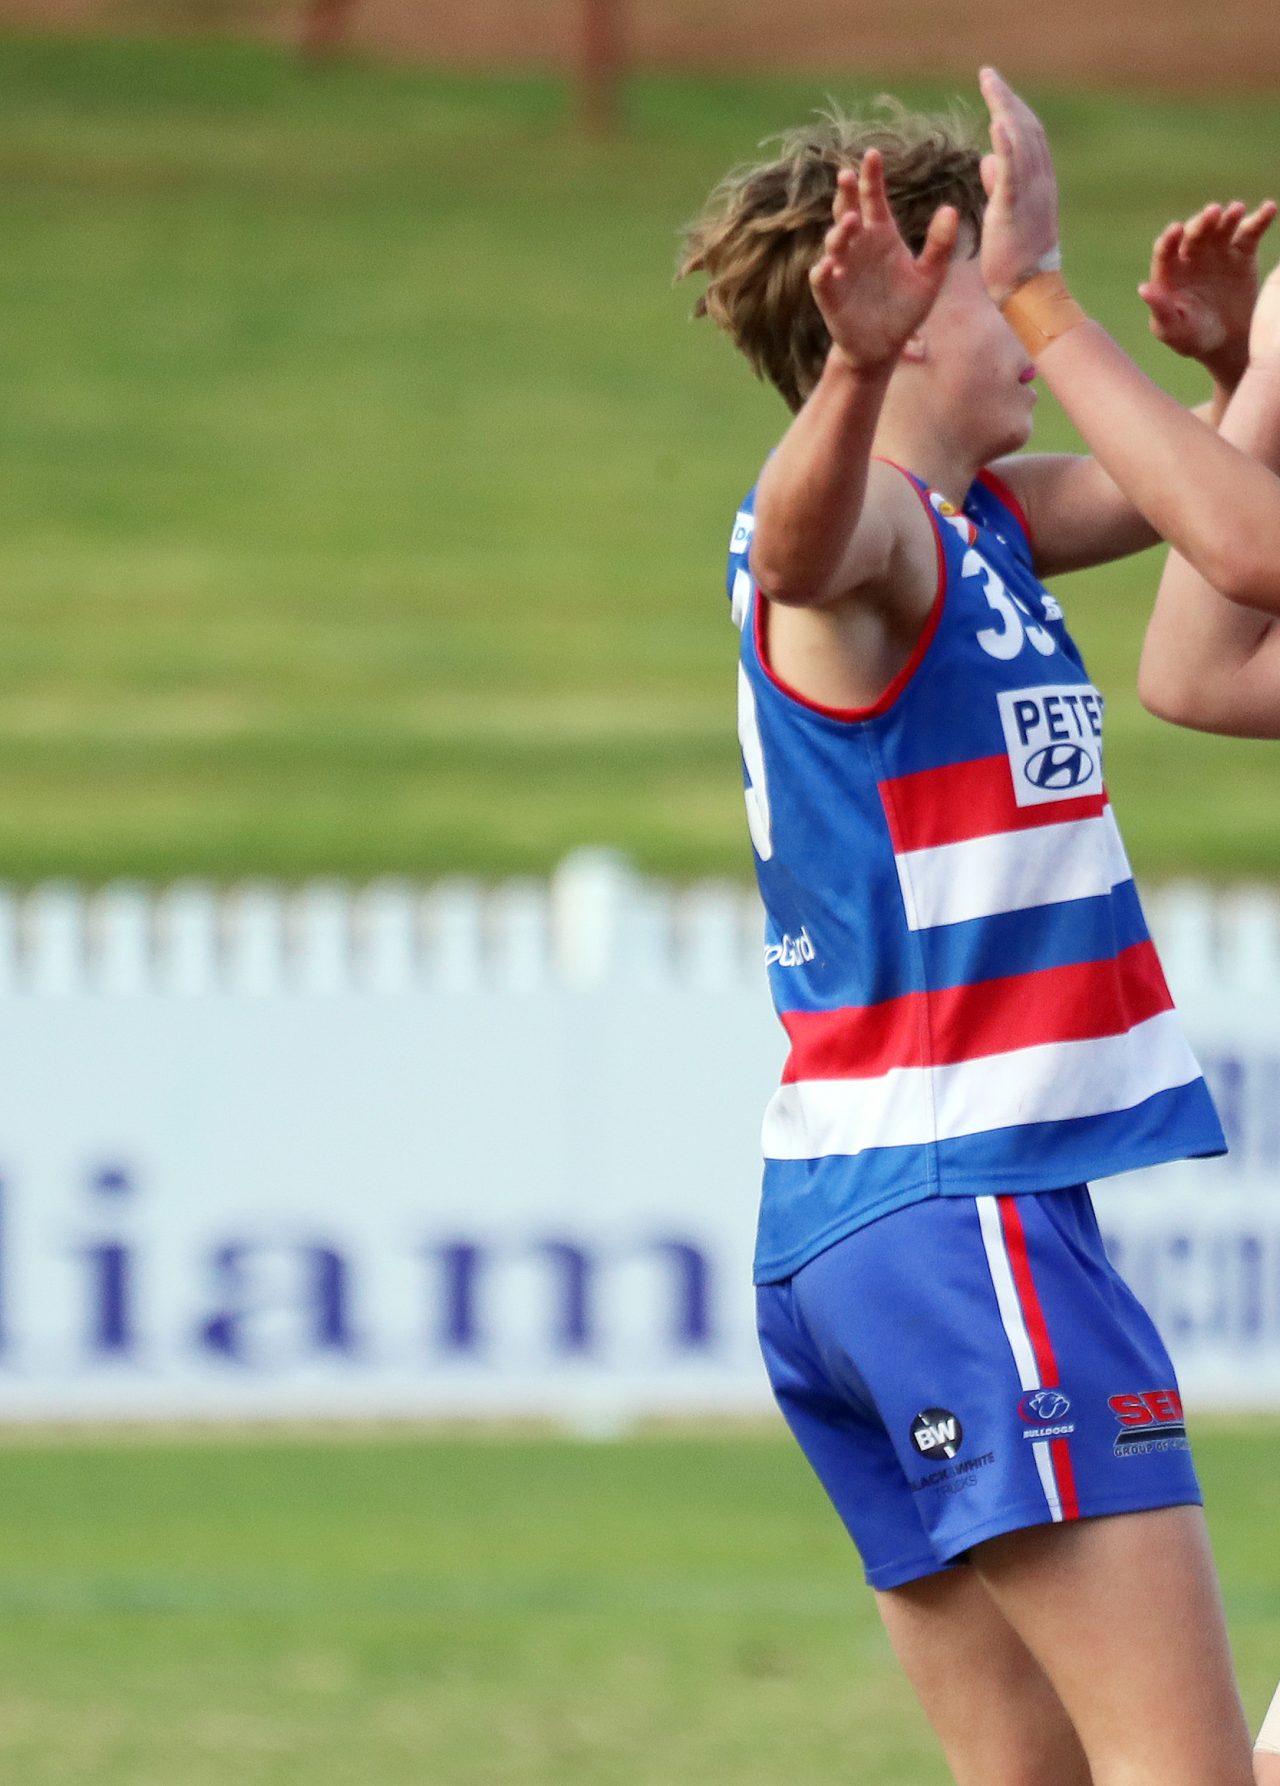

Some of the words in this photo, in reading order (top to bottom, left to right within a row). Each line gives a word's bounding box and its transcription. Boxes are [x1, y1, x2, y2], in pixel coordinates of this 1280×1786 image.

[0, 1158, 735, 1362] iam
[914, 1417, 956, 1451] BW
[1023, 1425, 1074, 1439] BULLDOGS
[1114, 1441, 1153, 1457] GROUP
[955, 1451, 995, 1475] WHITE
